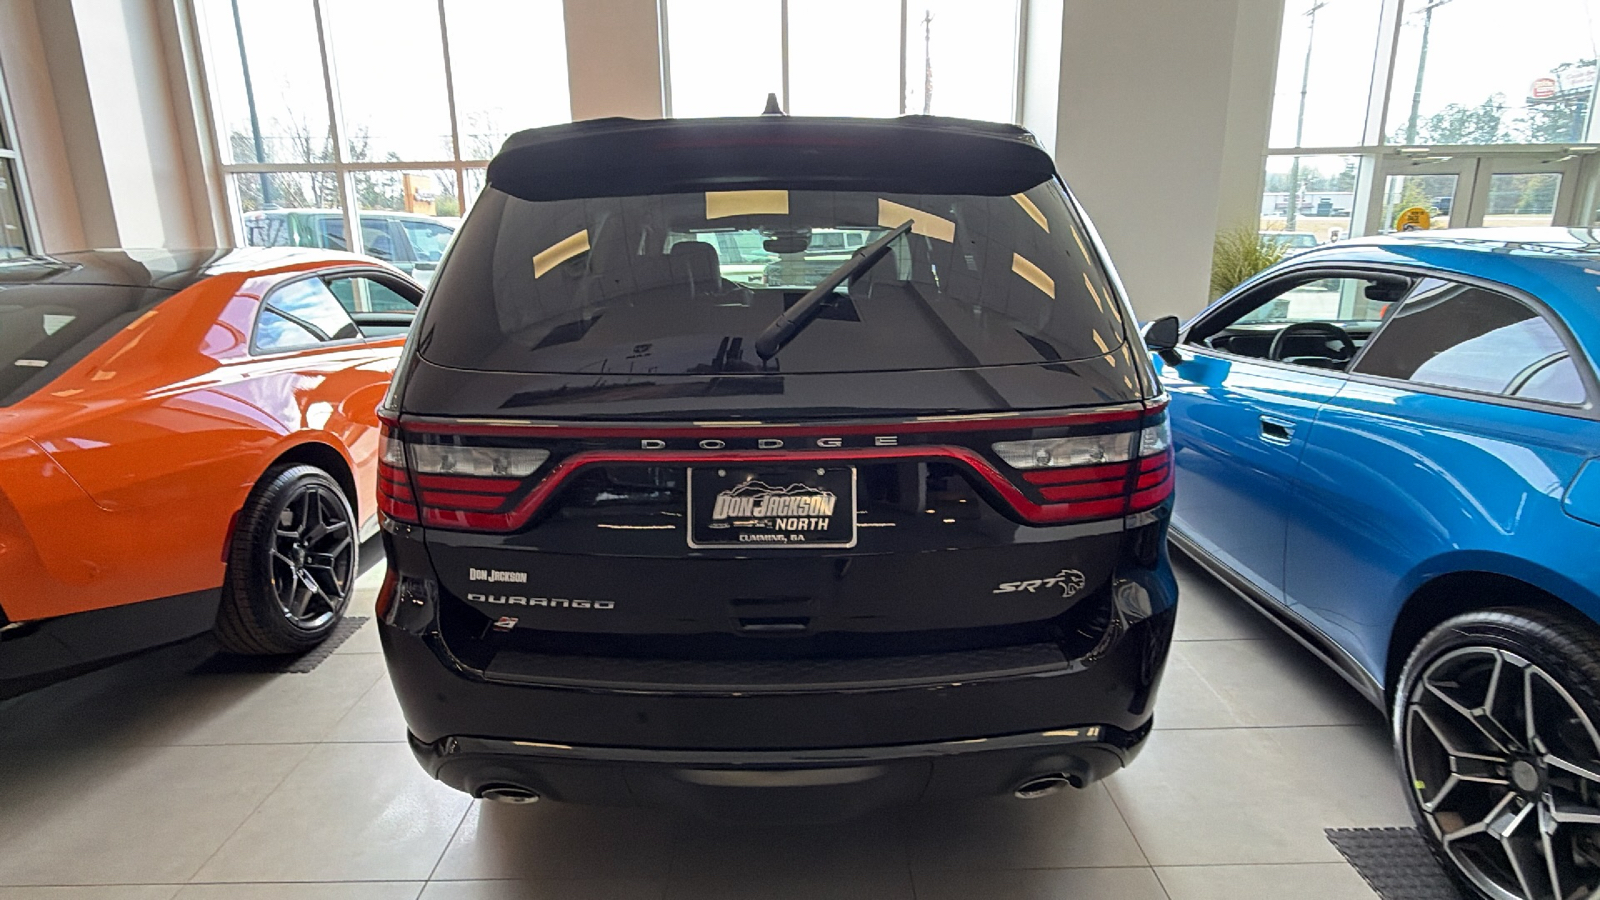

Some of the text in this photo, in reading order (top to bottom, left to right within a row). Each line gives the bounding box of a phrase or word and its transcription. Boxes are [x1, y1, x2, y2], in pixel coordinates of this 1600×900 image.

[641, 436, 898, 449] DODGE
[712, 495, 836, 520] DON JACKSON
[775, 518, 829, 531] NORTH
[469, 567, 528, 583] DON JACKSON
[992, 577, 1066, 594] SRT
[467, 593, 615, 609] DURANGO
